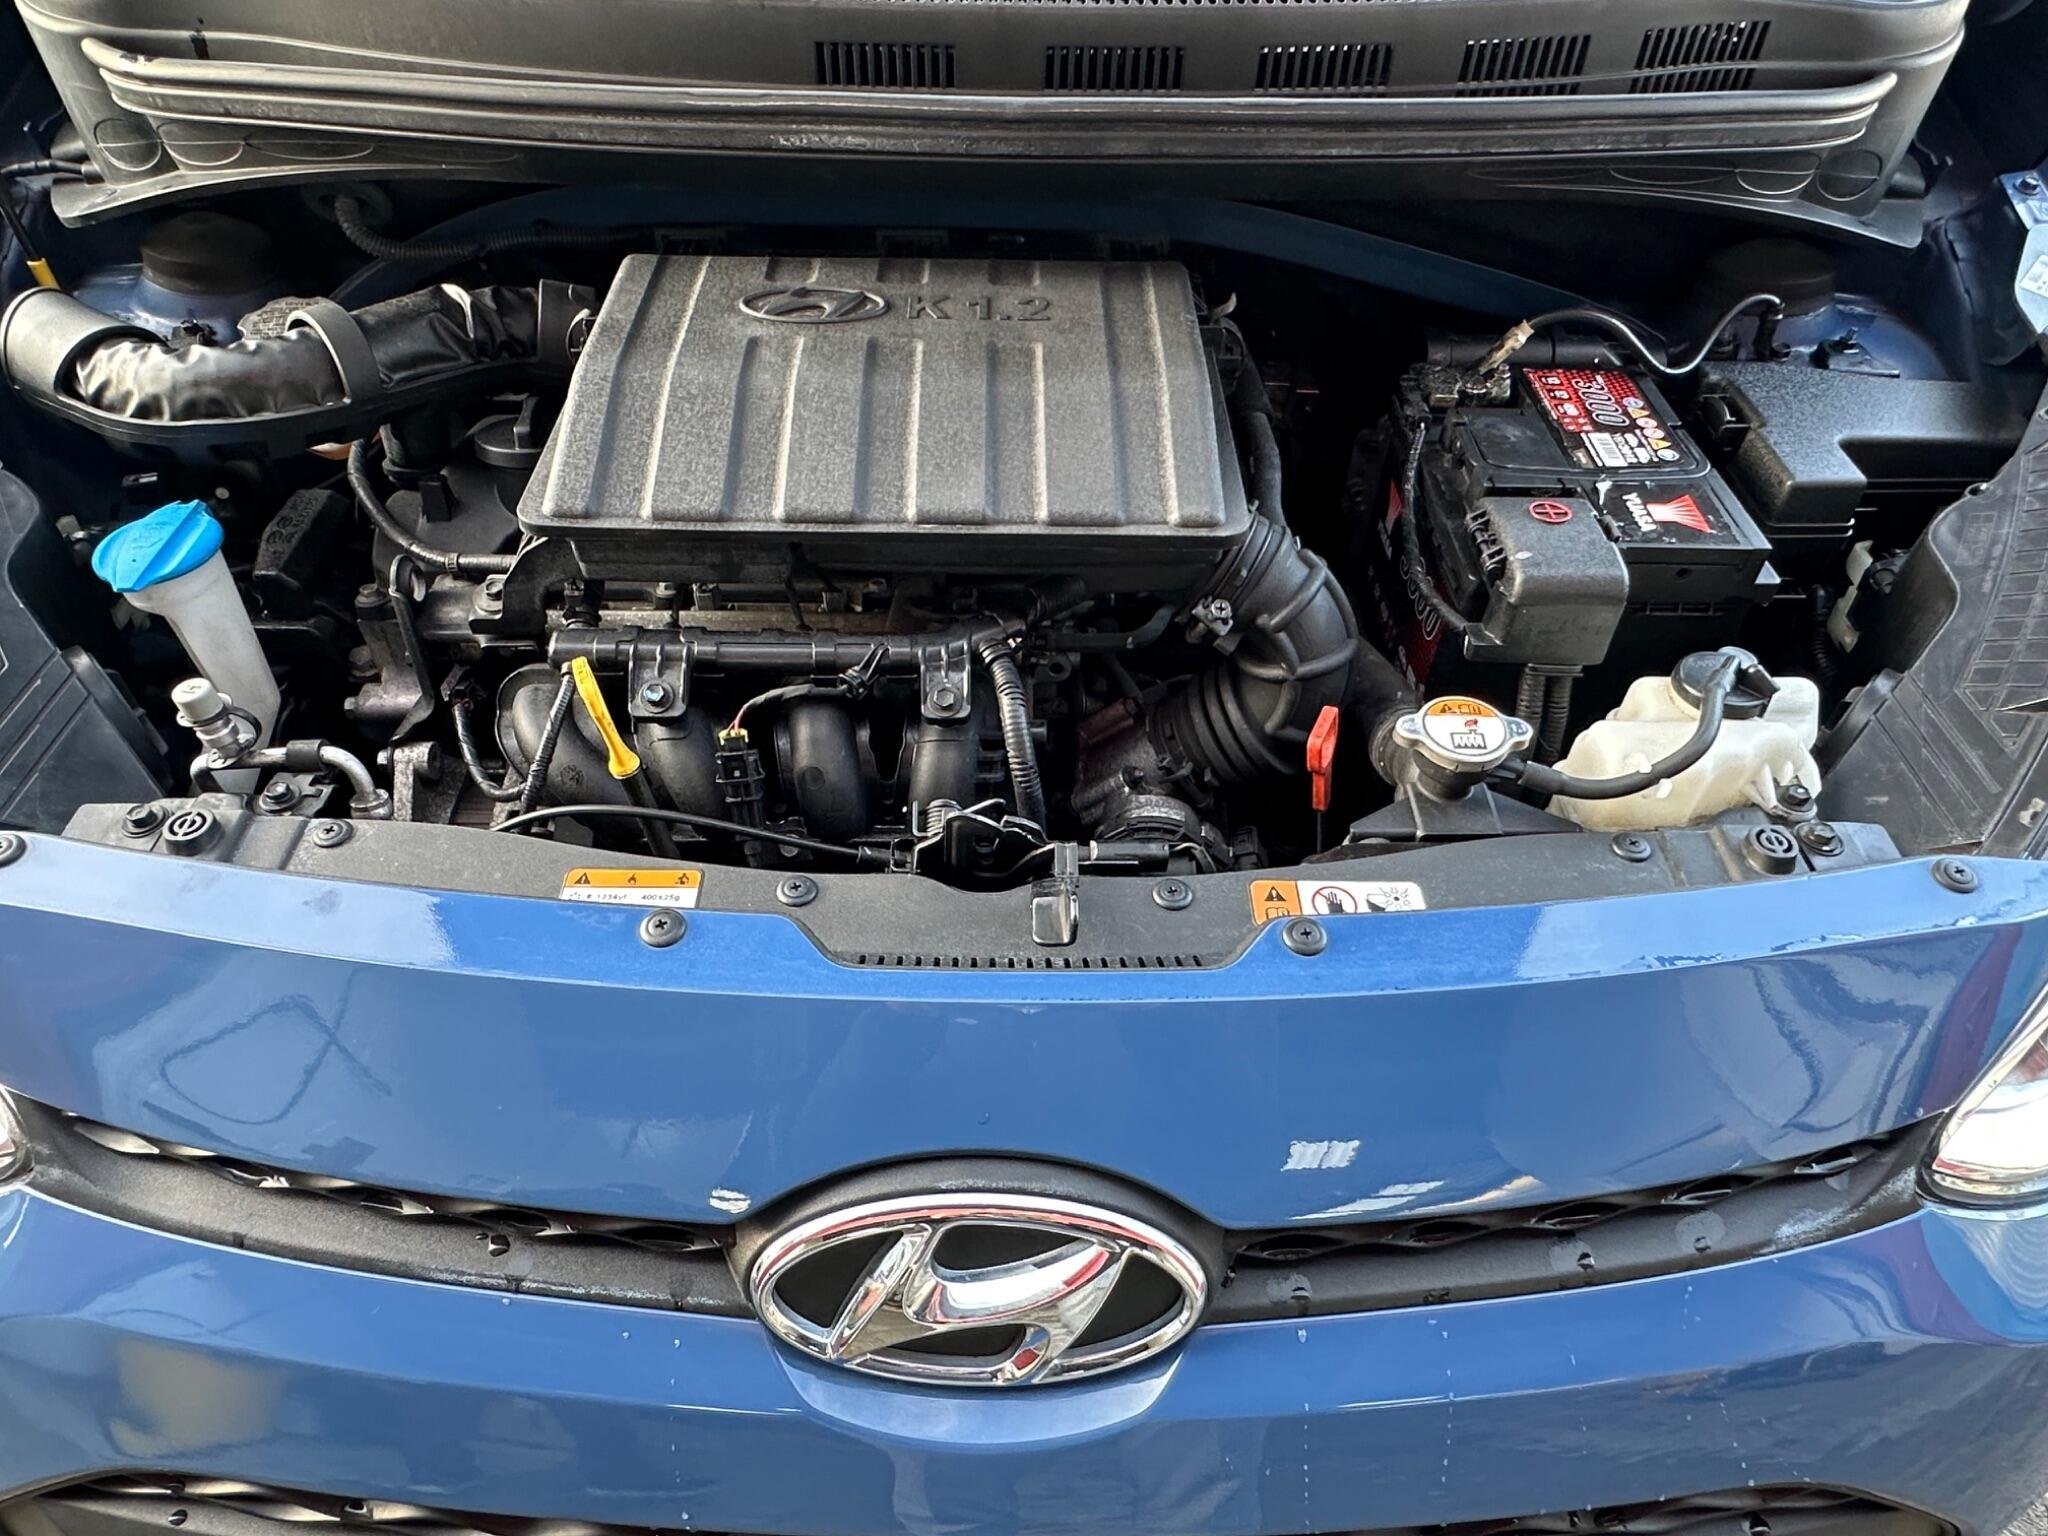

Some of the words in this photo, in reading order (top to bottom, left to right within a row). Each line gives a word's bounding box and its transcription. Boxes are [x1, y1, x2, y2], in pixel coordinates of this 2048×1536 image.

[907, 296, 952, 320] K
[965, 296, 1051, 321] 1.2
[1572, 377, 1630, 427] 3000
